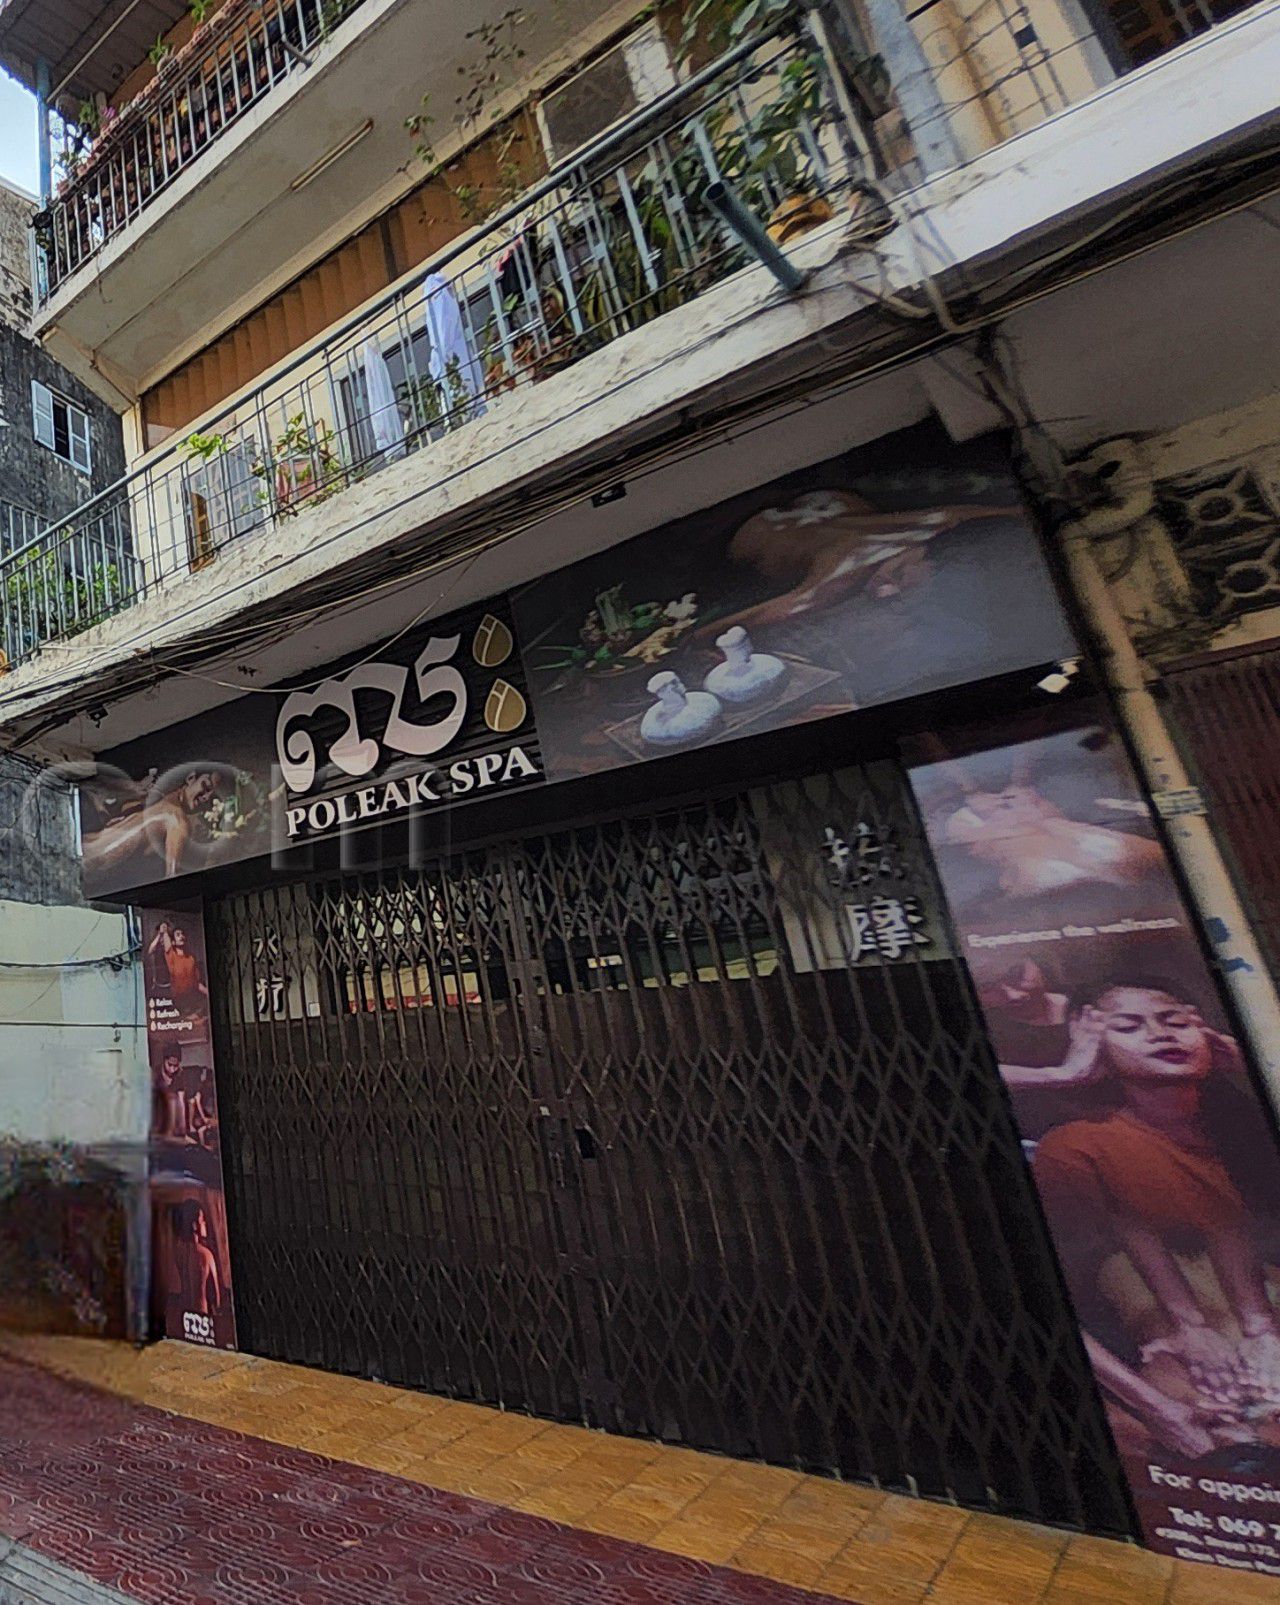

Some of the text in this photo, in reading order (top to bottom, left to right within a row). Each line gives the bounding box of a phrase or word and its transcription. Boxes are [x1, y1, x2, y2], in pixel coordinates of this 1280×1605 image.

[284, 746, 539, 838] POLEAK SPA
[156, 1008, 180, 1018] Refresh
[157, 1020, 193, 1031] Recharging
[1148, 1465, 1192, 1489] For
[1168, 1506, 1213, 1530] Tel:
[1217, 1515, 1267, 1538] 069
